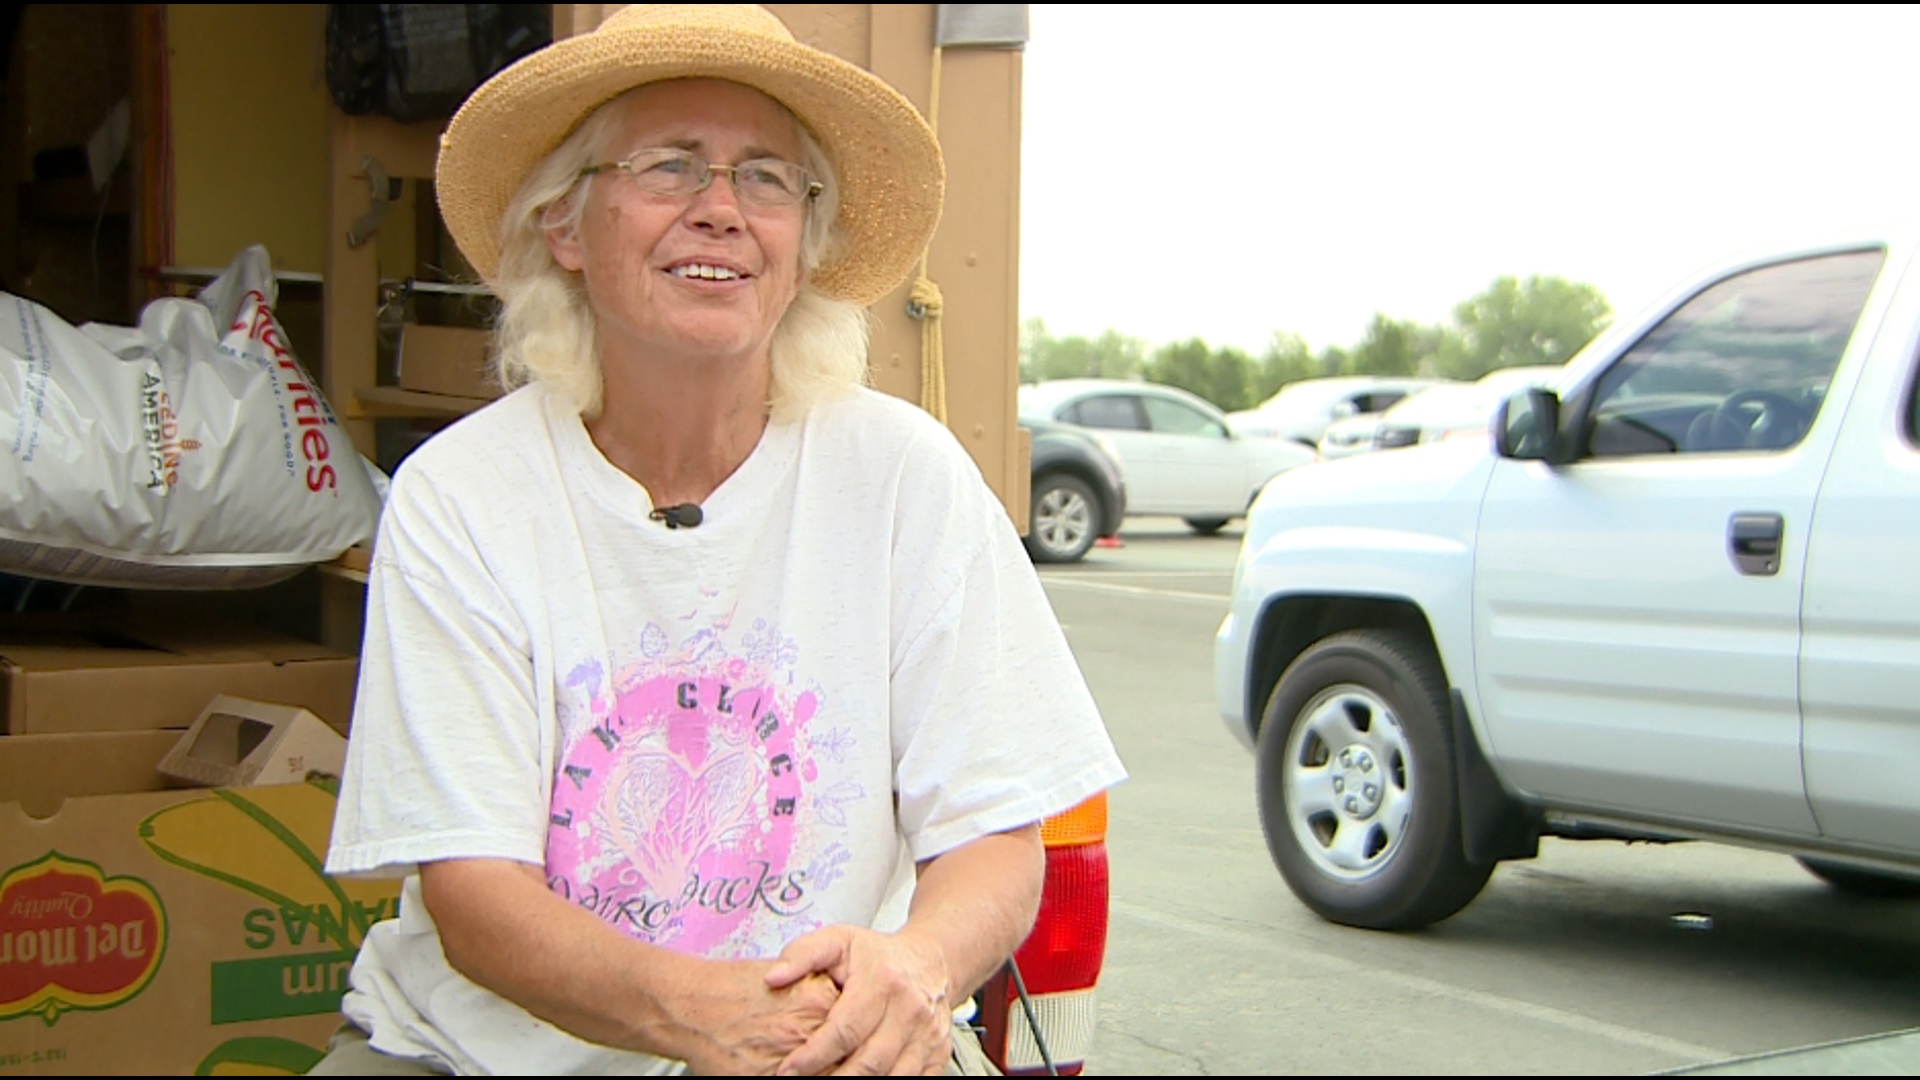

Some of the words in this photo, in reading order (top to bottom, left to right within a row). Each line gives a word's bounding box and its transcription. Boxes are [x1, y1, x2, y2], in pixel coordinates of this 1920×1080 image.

[550, 715, 625, 830] LAK
[9, 891, 93, 919] Quality
[243, 897, 400, 949] ANAS
[85, 919, 146, 963] Del
